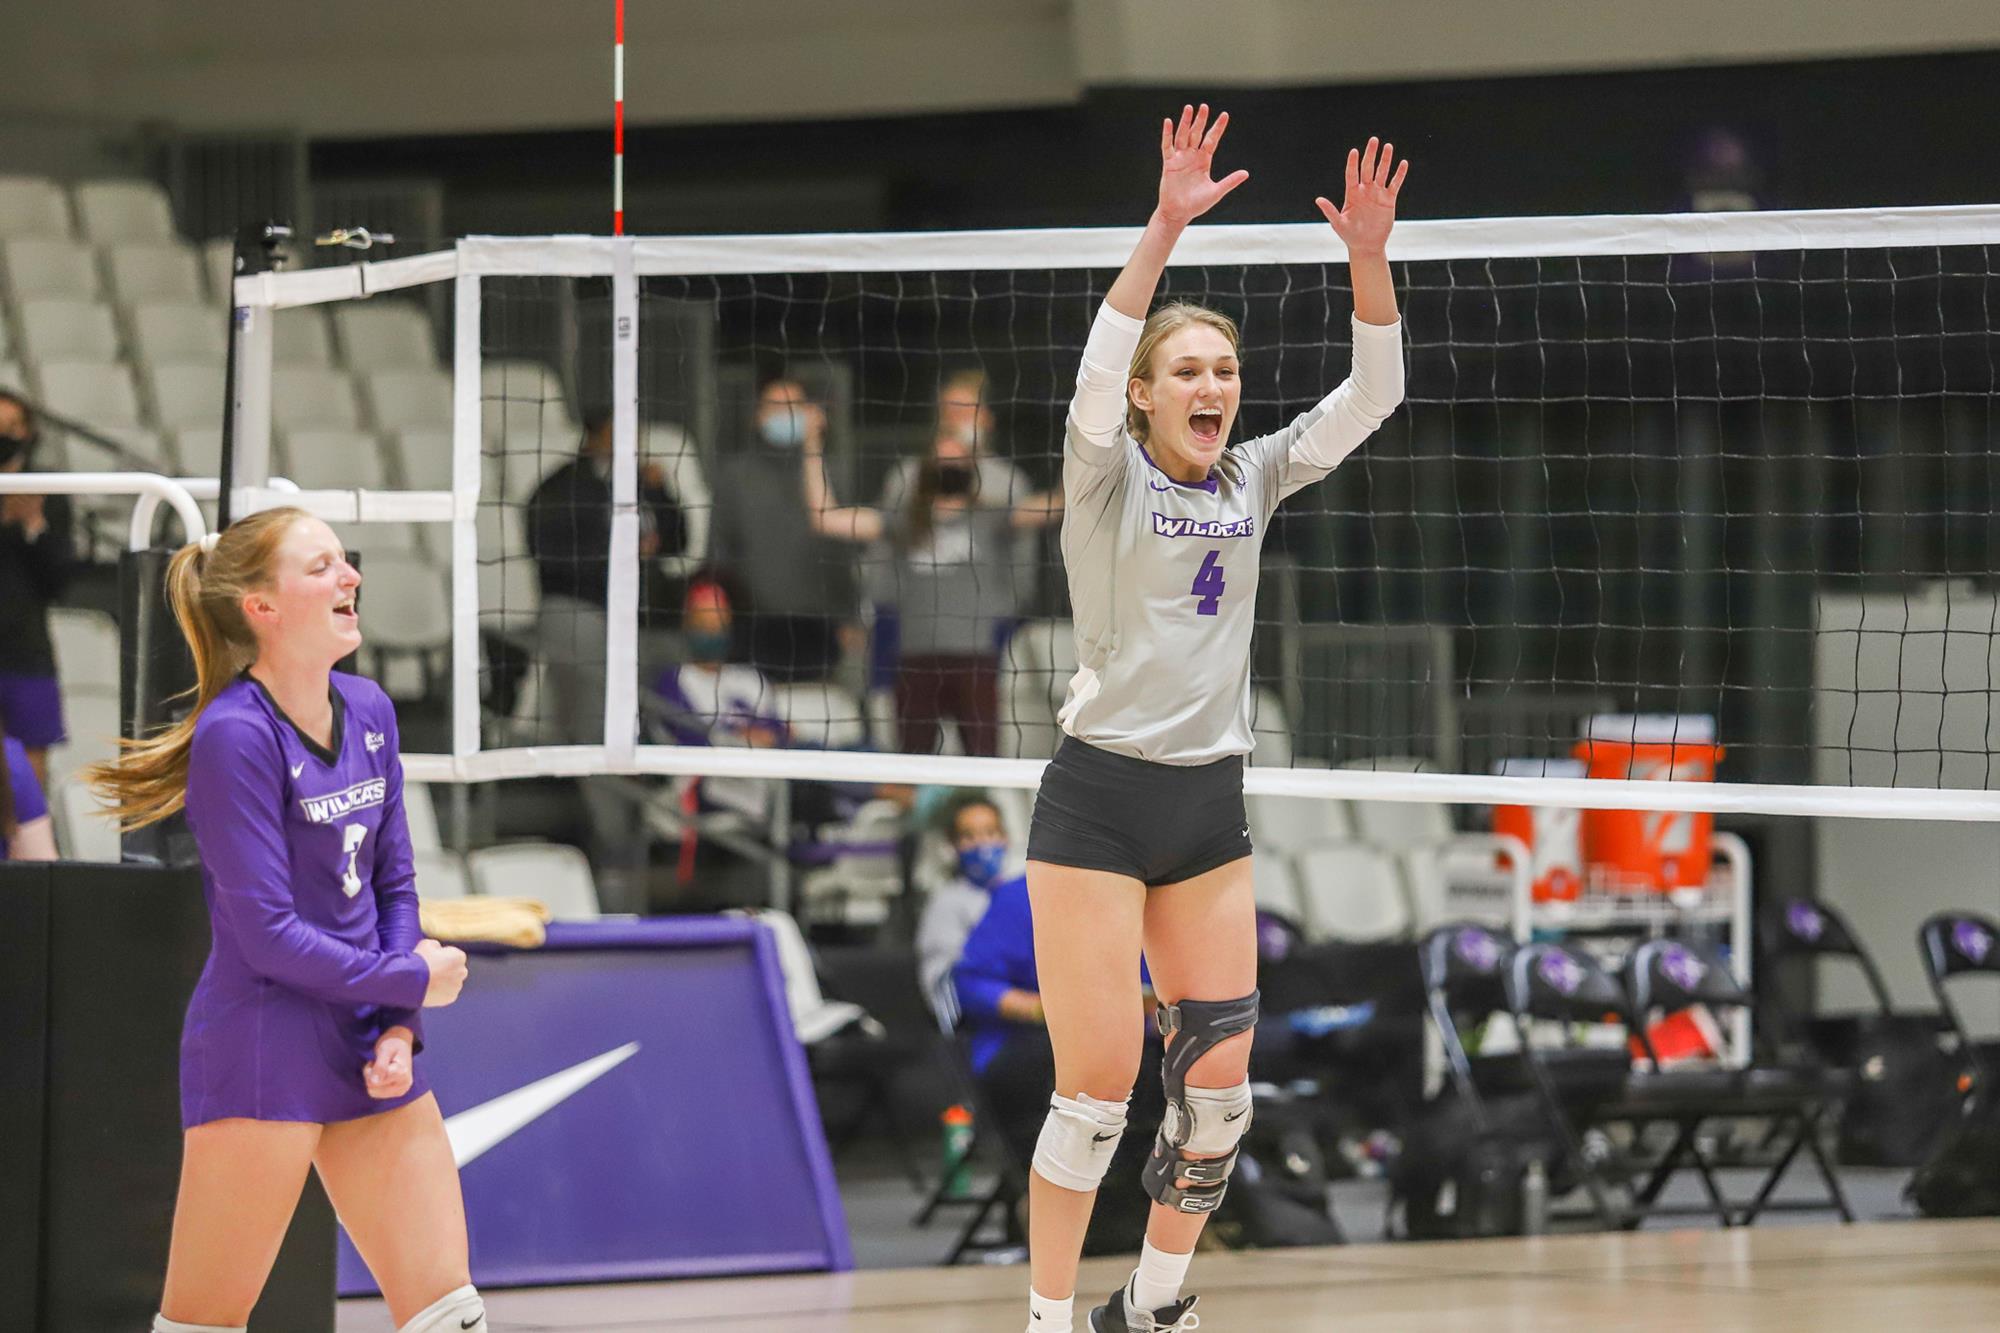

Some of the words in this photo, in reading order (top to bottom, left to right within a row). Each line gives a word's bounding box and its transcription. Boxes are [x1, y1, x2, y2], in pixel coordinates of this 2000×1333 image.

[1153, 512, 1253, 538] WILDCA
[1191, 550, 1226, 616] 4
[301, 778, 385, 823] WILCAS
